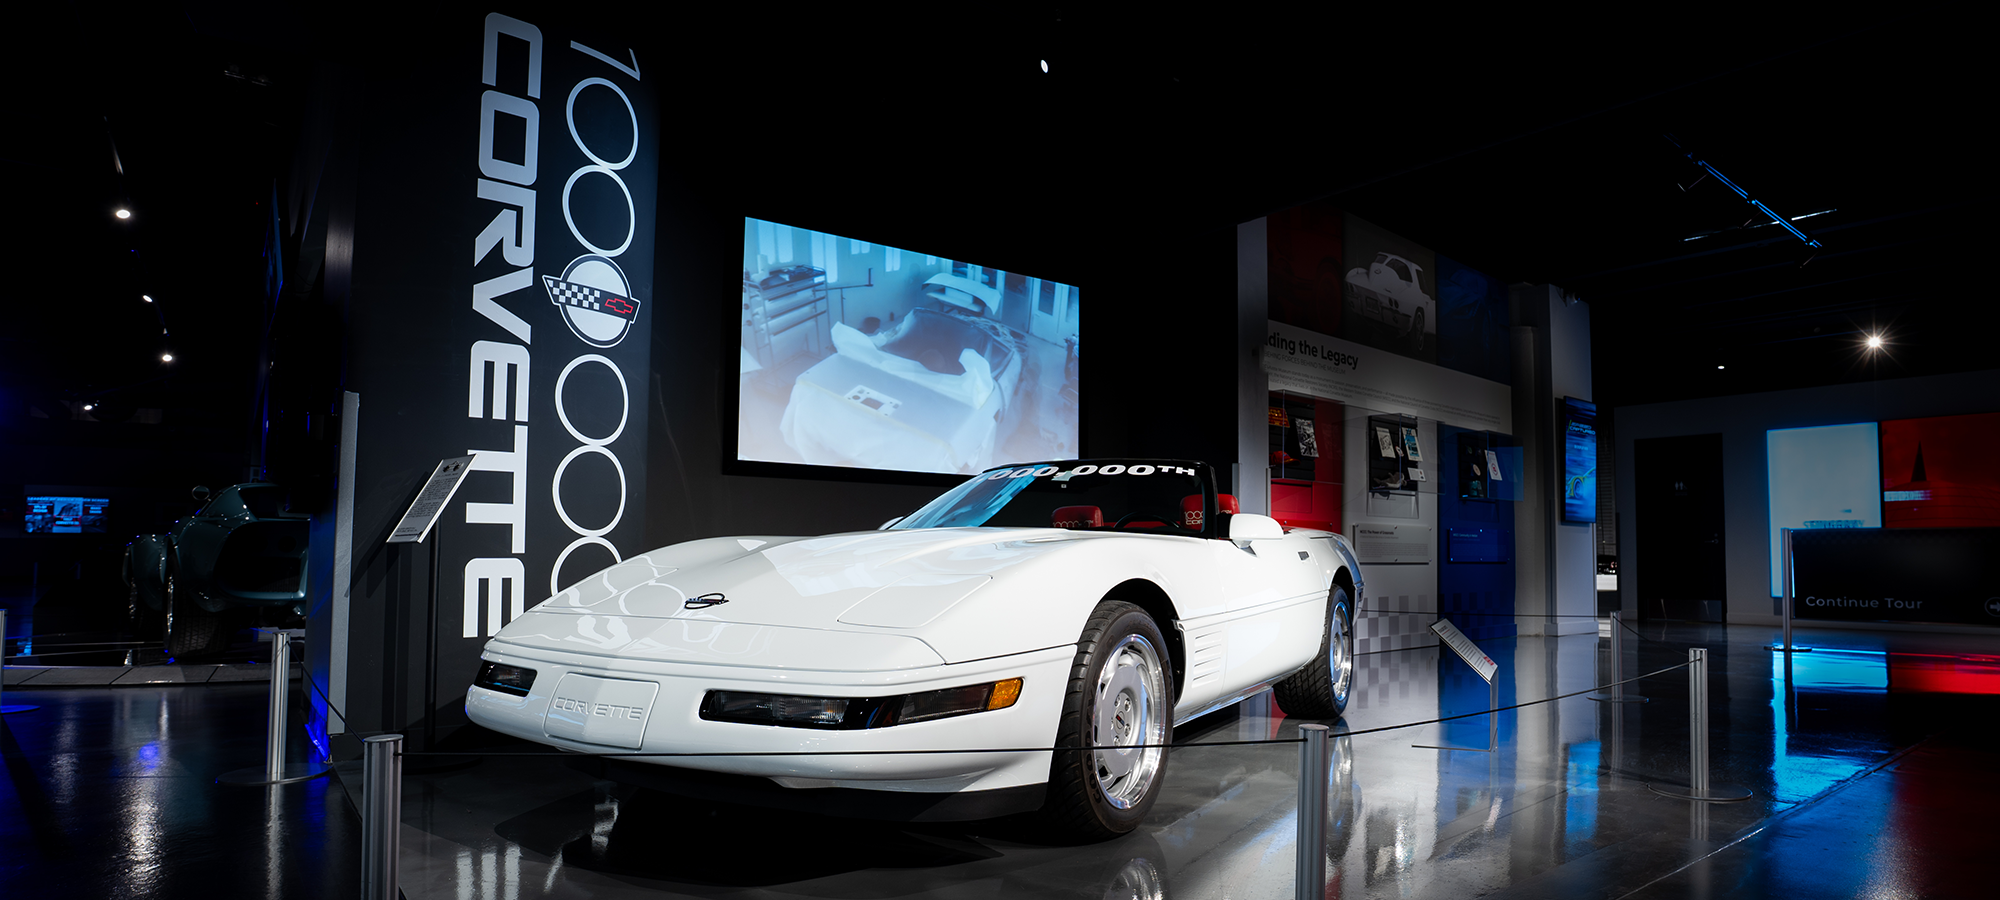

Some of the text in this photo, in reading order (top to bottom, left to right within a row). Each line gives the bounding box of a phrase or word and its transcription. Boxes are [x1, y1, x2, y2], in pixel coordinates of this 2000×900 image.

[463, 12, 543, 638] CORVETTE
[1265, 332, 1359, 370] ding the Legacy
[1806, 596, 1923, 609] Continue Tour
[554, 697, 643, 720] CORVETTE
